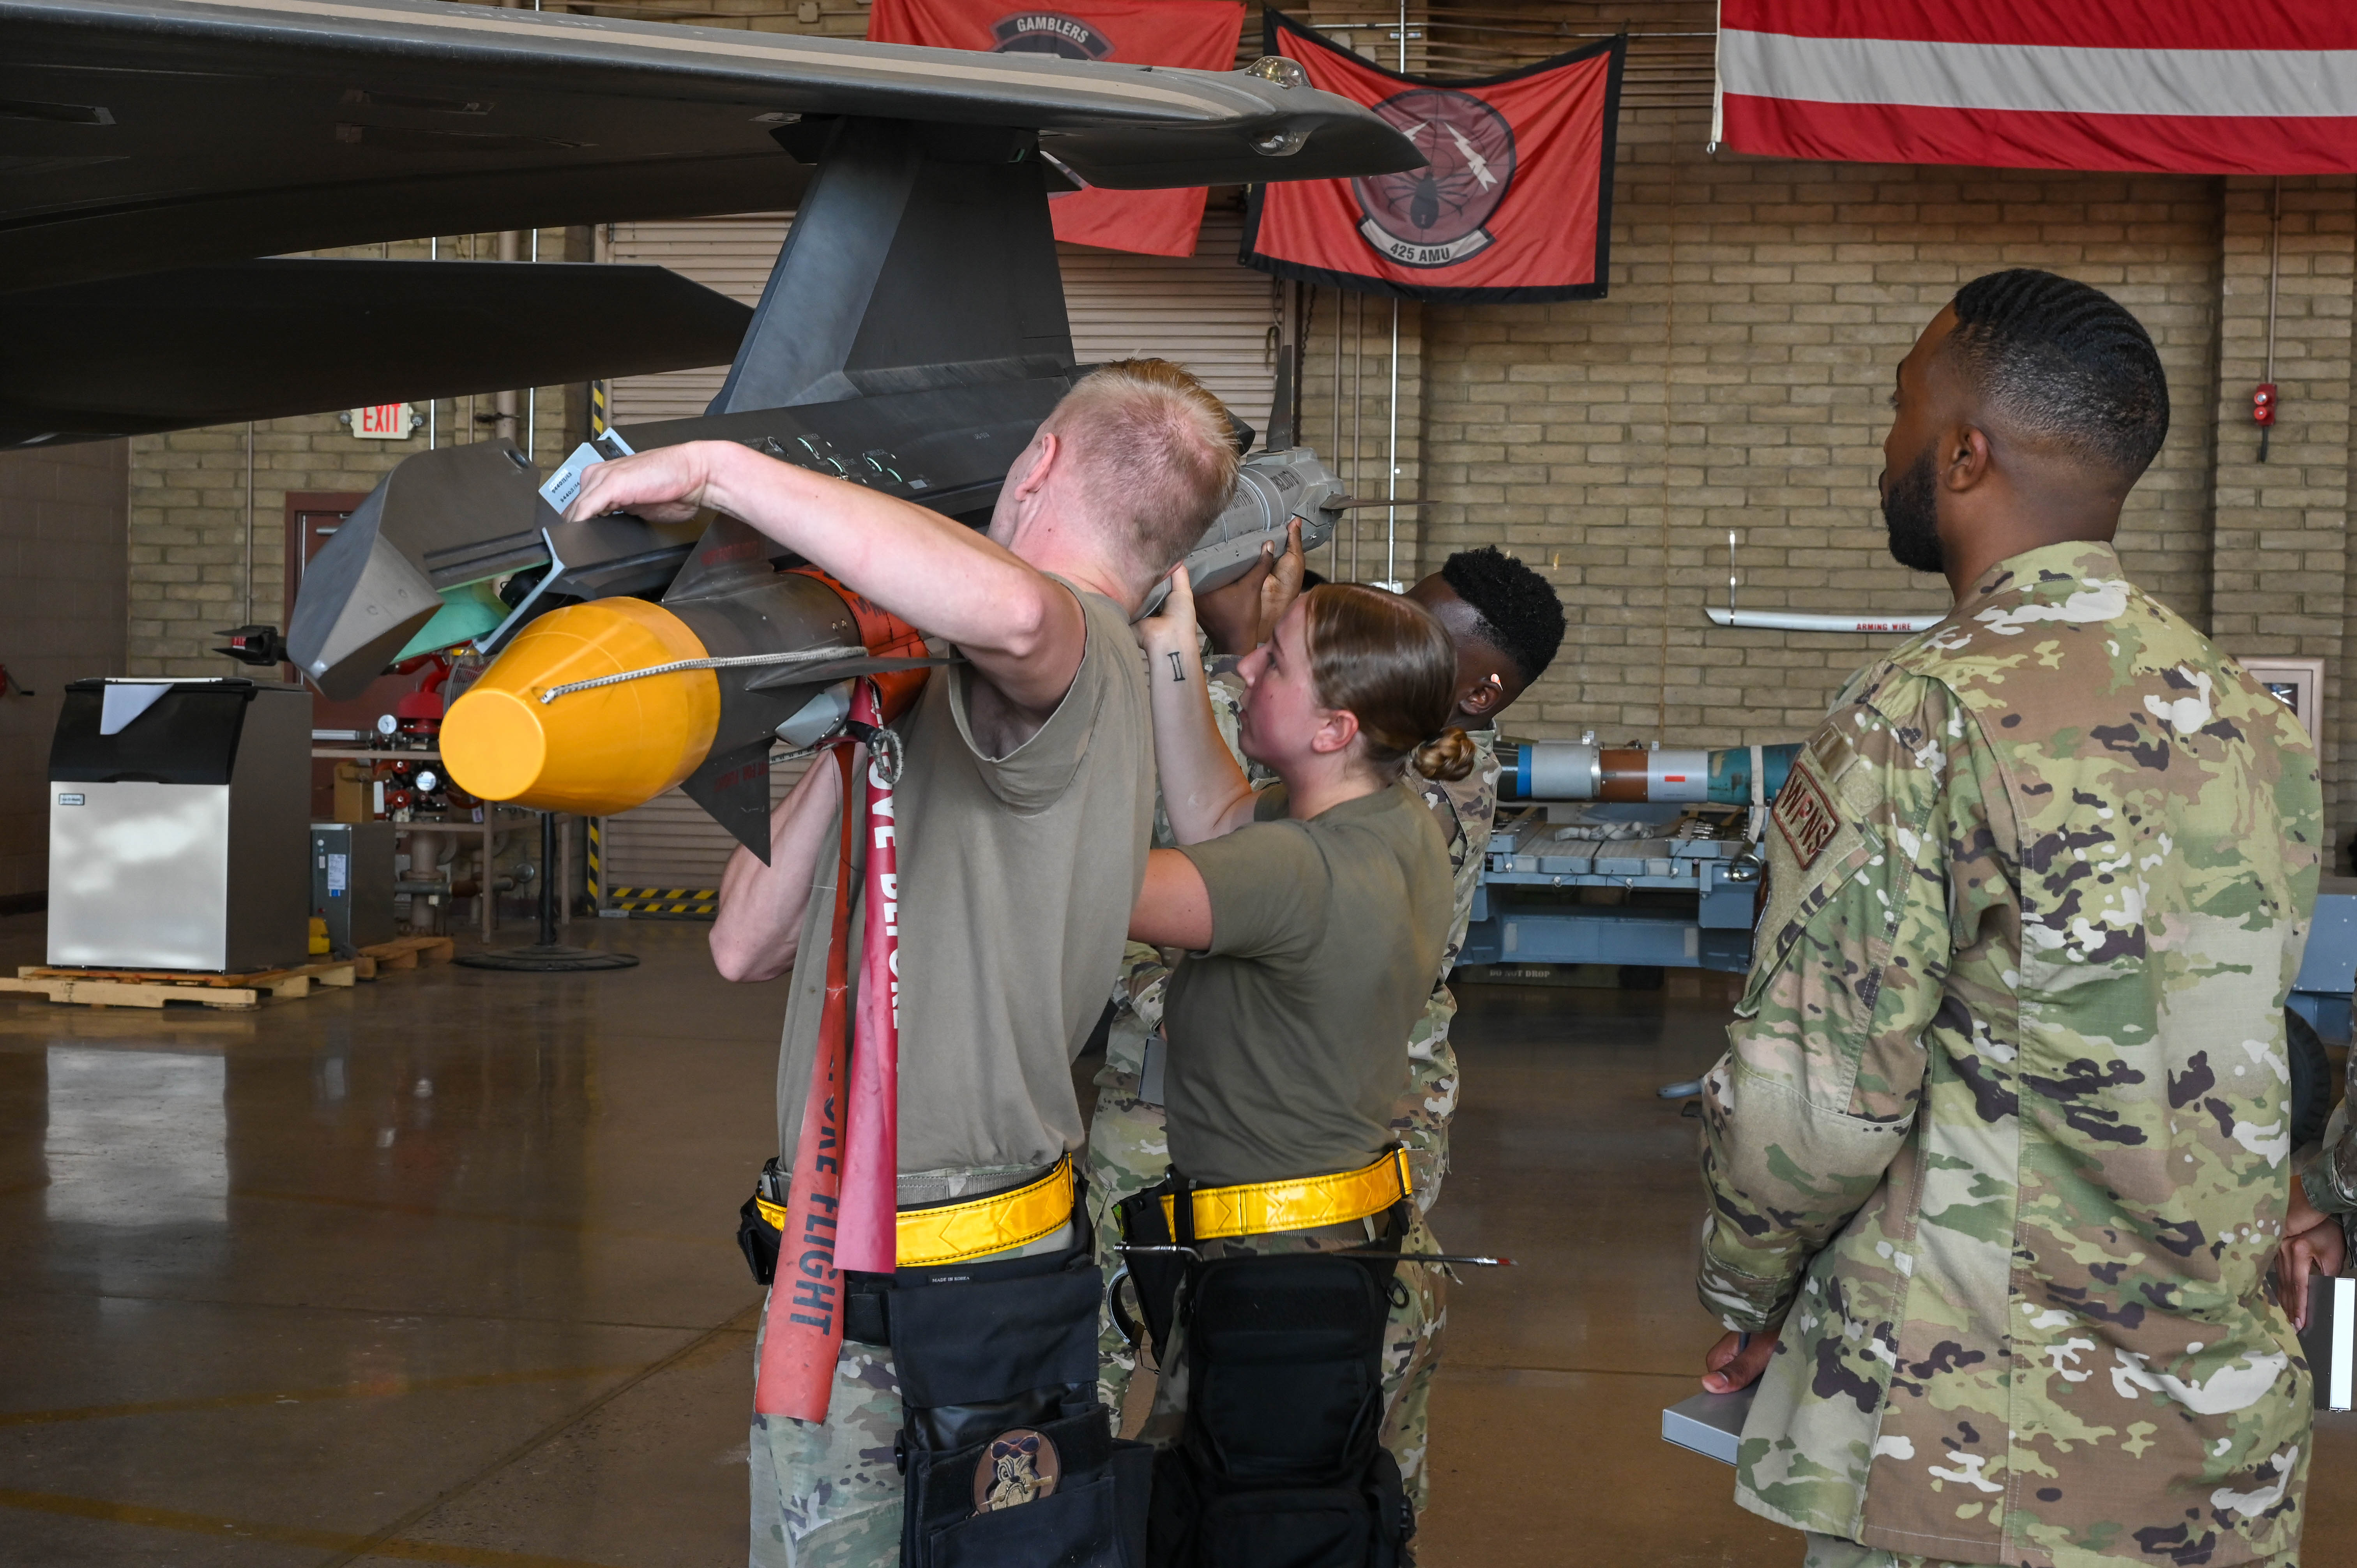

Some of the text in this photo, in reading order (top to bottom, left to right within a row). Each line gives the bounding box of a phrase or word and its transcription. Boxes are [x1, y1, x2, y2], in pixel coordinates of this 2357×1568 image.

[1017, 16, 1089, 43] GAMBLERS
[1390, 243, 1450, 262] 425 AMU
[363, 403, 401, 433] EXIT
[1781, 773, 1829, 856] WPNS
[1525, 969, 1550, 978] DROP
[789, 1192, 838, 1336] FLIGHT
